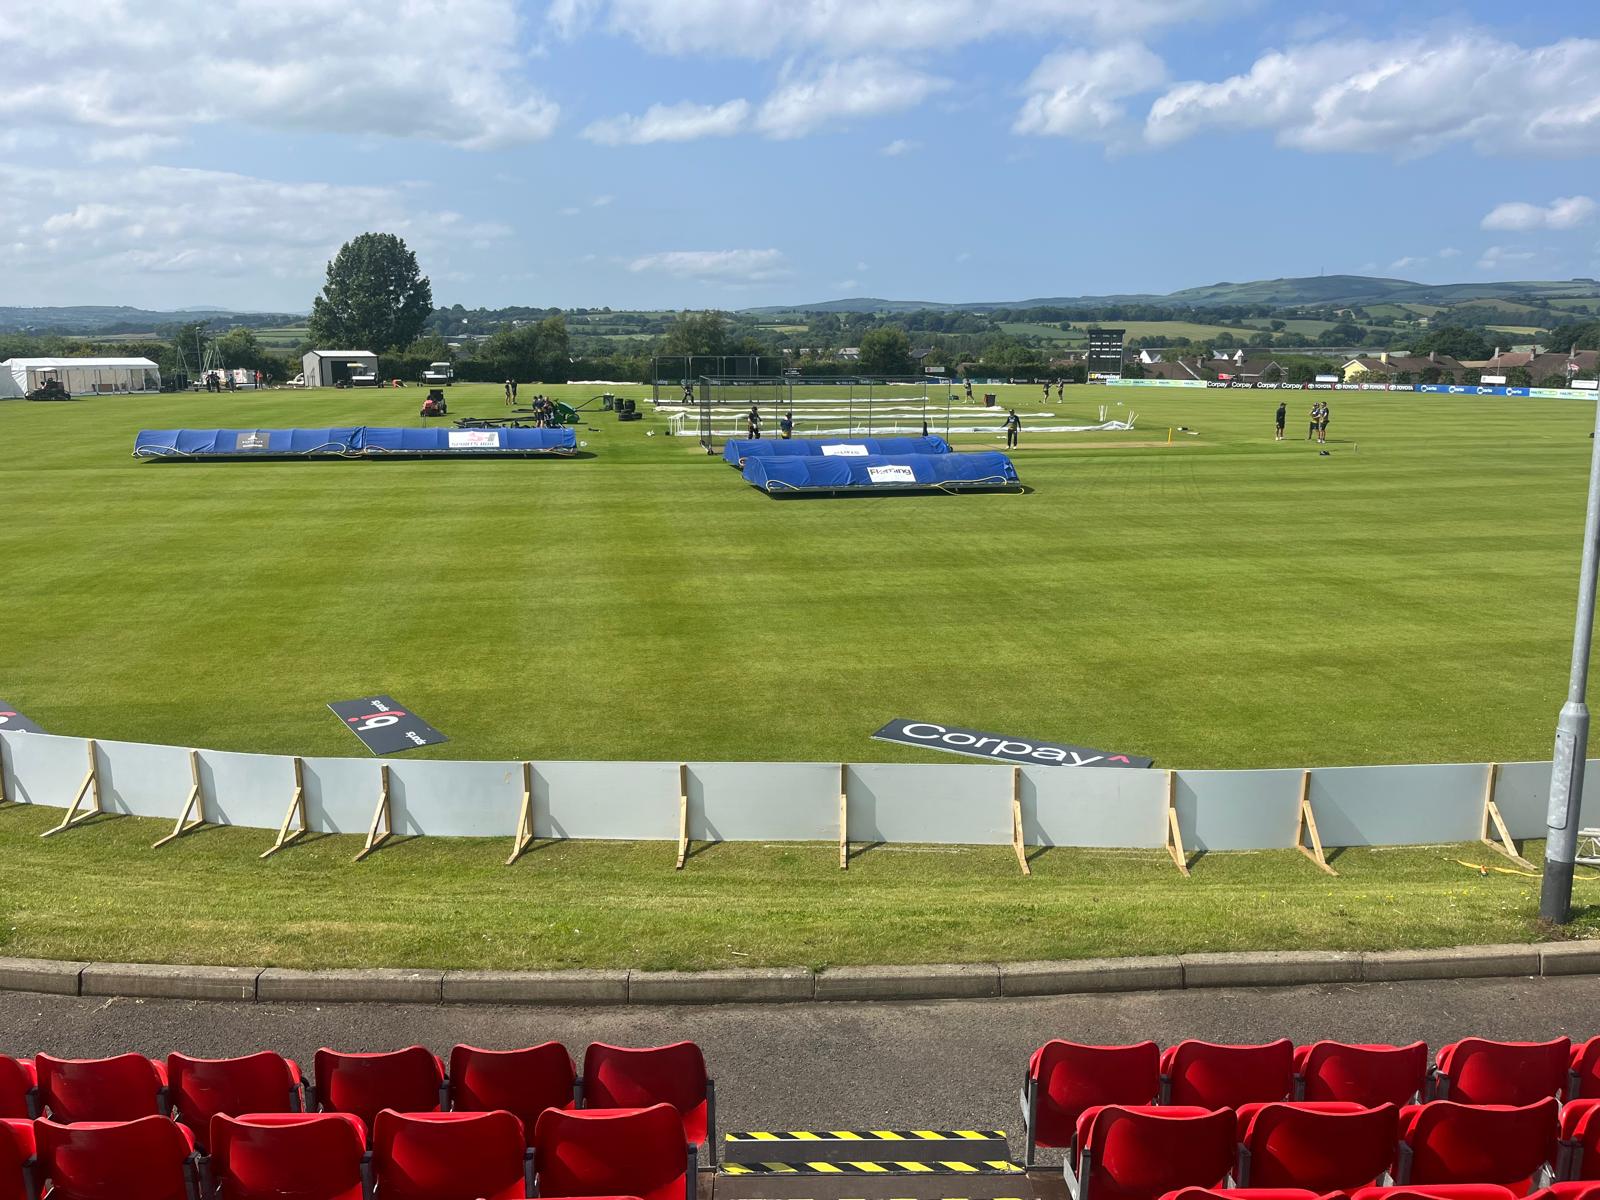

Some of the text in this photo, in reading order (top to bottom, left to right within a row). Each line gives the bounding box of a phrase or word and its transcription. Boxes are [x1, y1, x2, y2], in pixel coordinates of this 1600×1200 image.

[1231, 381, 1253, 389] Corpay
[1281, 382, 1303, 390] Corpay
[869, 467, 912, 476] Fleming
[370, 699, 390, 712] sports
[405, 731, 427, 745] sports
[902, 723, 1104, 767] Corpay
